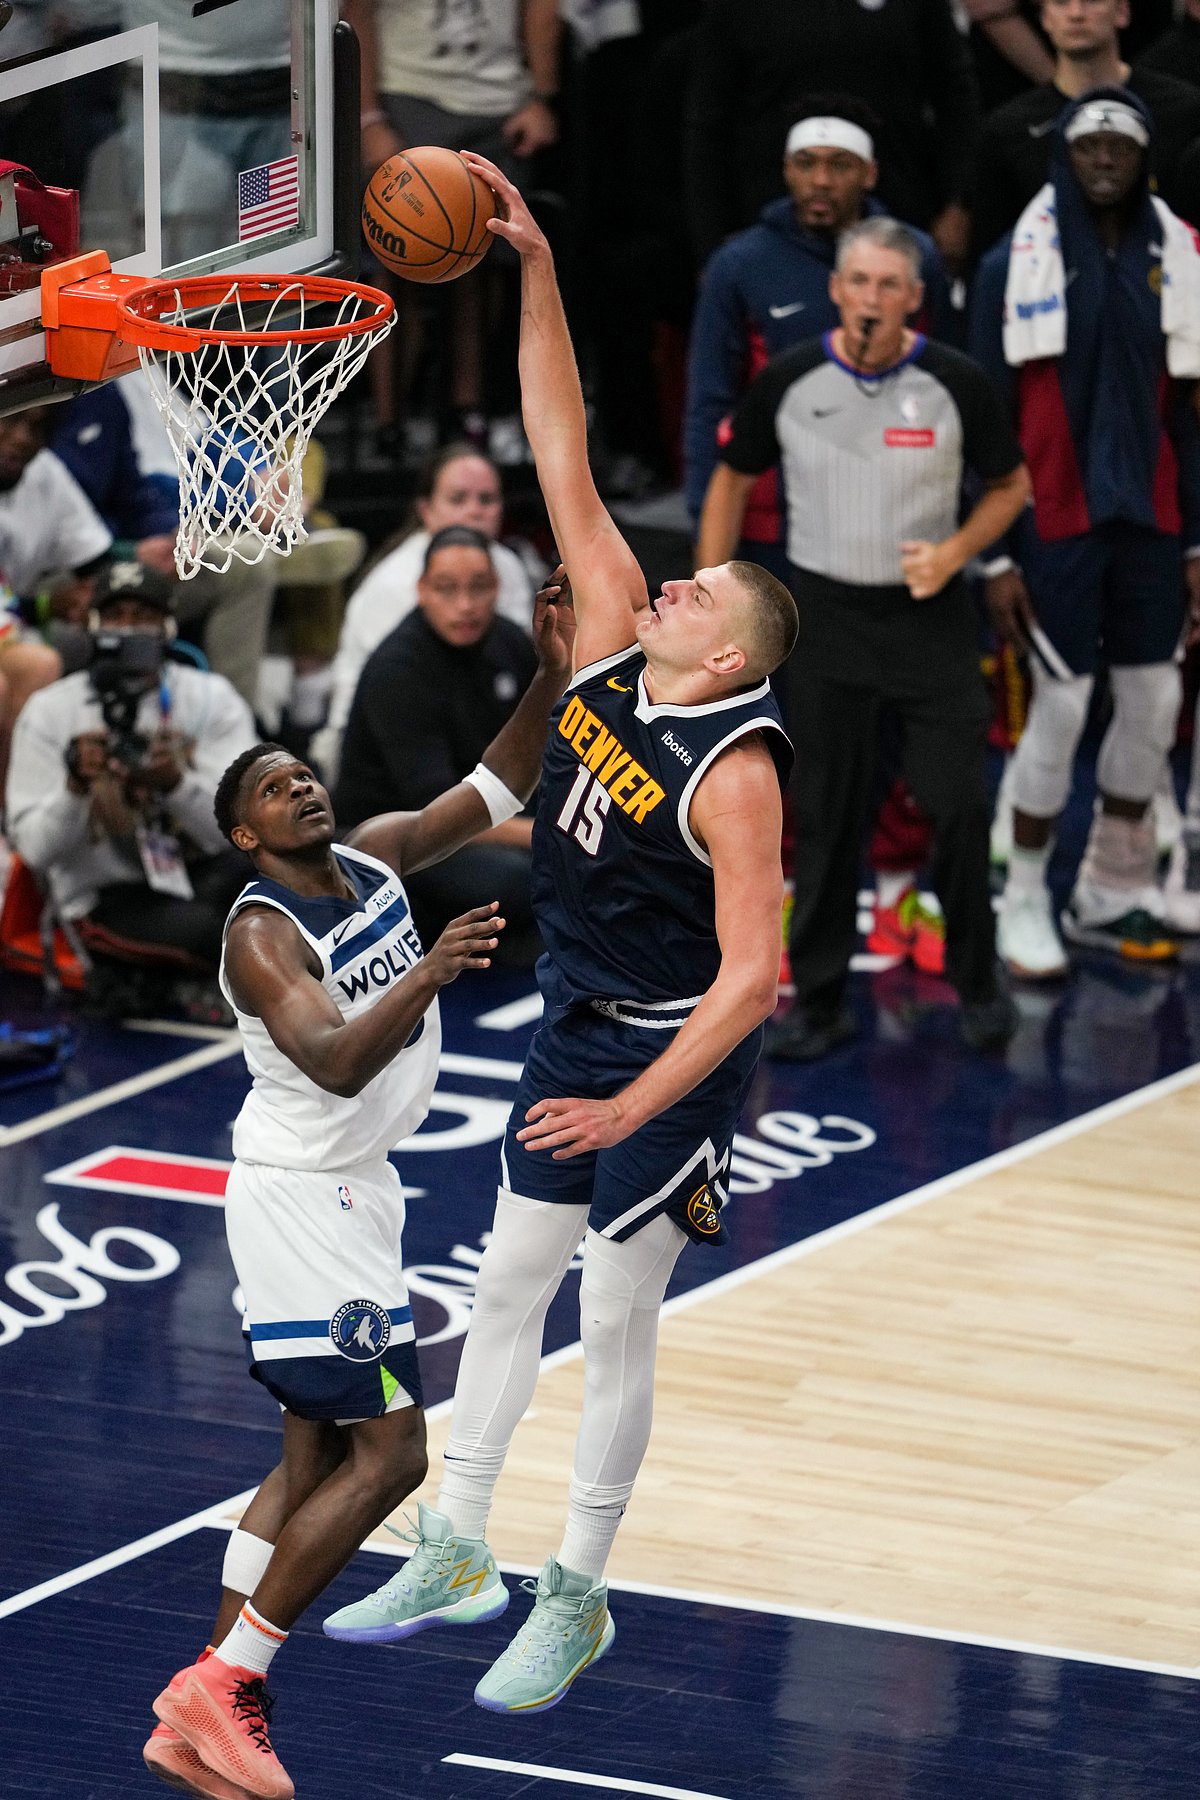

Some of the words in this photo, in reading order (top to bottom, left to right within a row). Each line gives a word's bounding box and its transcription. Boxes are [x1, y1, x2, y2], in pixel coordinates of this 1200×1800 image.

[557, 694, 667, 825] DENVER
[660, 729, 693, 767] ibotta
[556, 763, 612, 856] 15
[337, 923, 425, 1003] WOLVE
[332, 1302, 356, 1343] MINNESOTA
[357, 1300, 390, 1347] TIMBERWOLVES
